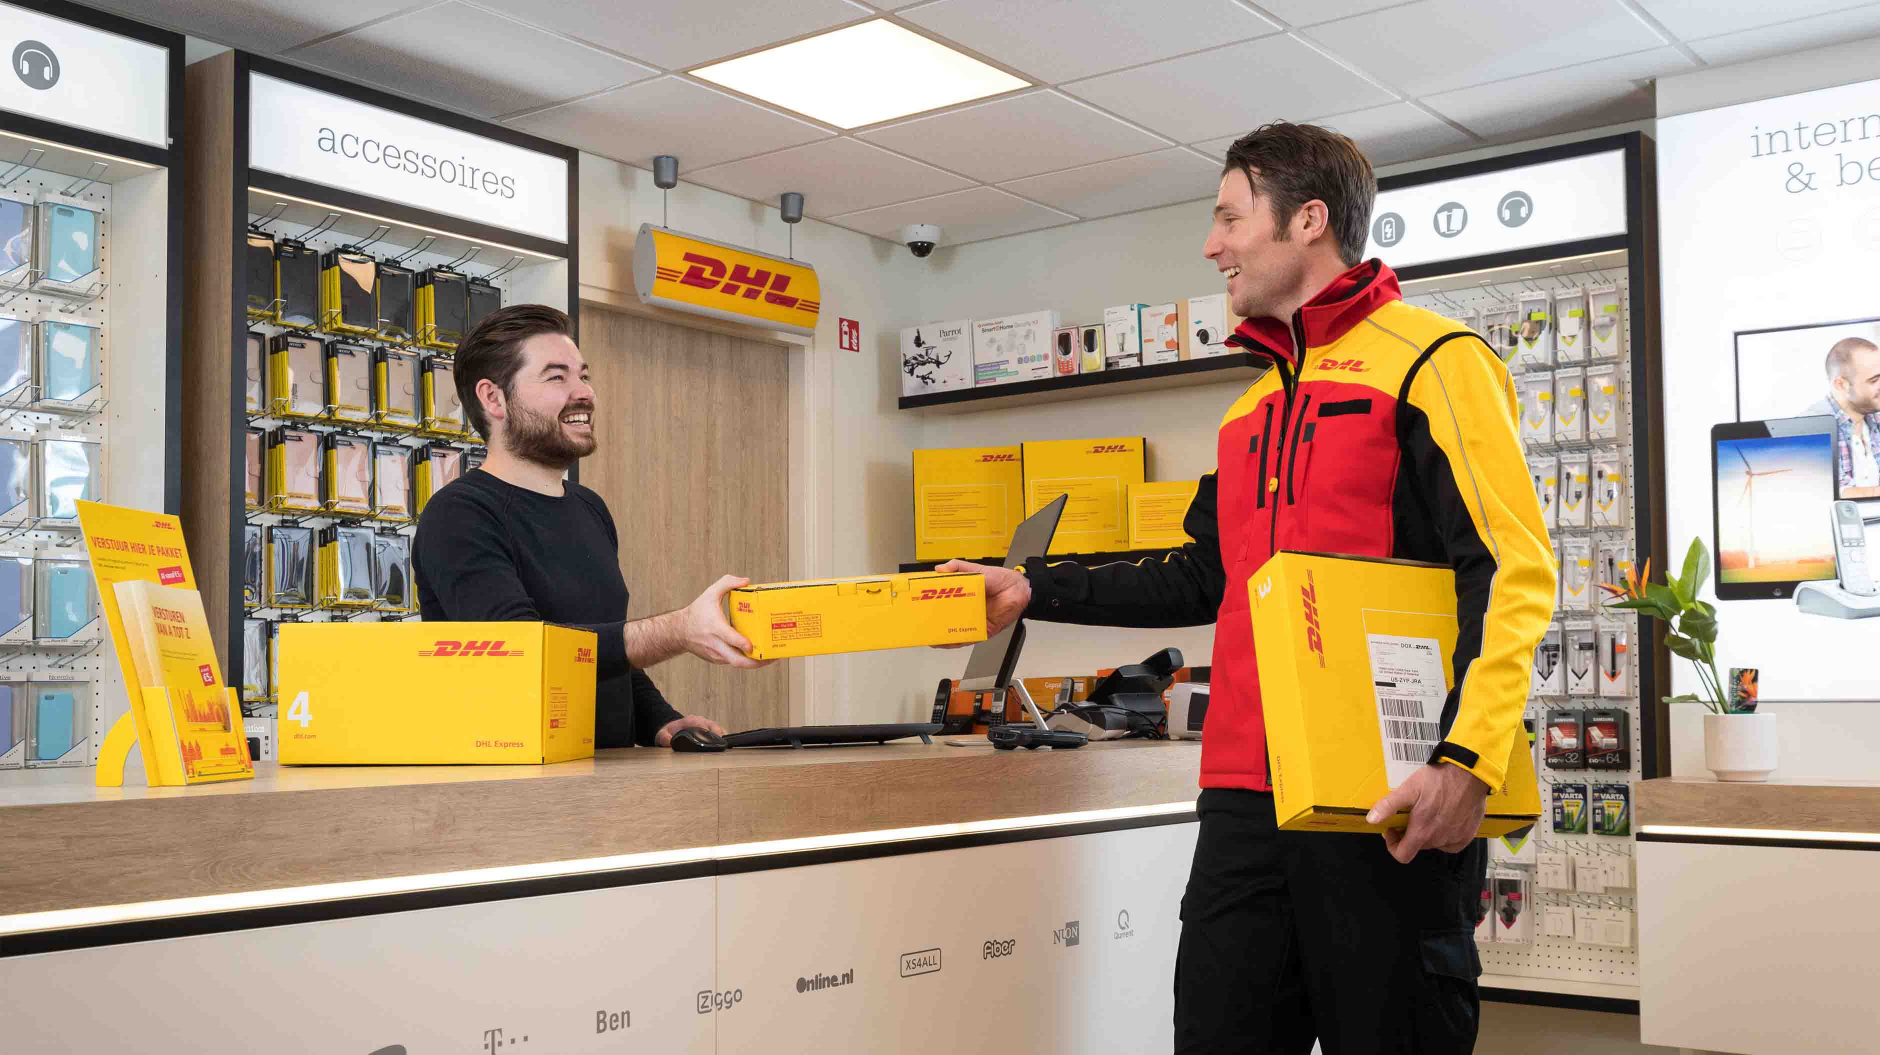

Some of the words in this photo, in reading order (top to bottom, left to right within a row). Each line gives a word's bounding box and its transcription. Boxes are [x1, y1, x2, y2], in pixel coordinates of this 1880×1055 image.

[318, 126, 516, 200] accessoires
[1785, 162, 1818, 194] &
[679, 252, 800, 308] DHL
[939, 327, 962, 338] Parrot
[1319, 359, 1365, 373] DHL
[1092, 445, 1127, 454] DHL
[982, 454, 1016, 463] DHL
[91, 535, 129, 553] VERSTUUR
[129, 541, 147, 555] HIER
[156, 545, 182, 559] PAKKET
[920, 586, 967, 600] DHL
[152, 606, 186, 624] VERSTUREN
[1301, 584, 1324, 655] DHL
[156, 623, 168, 636] VAN
[172, 625, 184, 639] TOT
[959, 626, 977, 634] Express
[432, 640, 510, 657] DHL
[287, 691, 313, 728] 4
[475, 740, 492, 748] DHL
[494, 740, 524, 749] Express
[1565, 752, 1579, 763] 32
[1606, 752, 1620, 764] 64
[1052, 925, 1079, 945] NUON
[905, 955, 938, 971] XS4ALL
[796, 968, 854, 993] Online.nl
[596, 1009, 631, 1034] Ben
